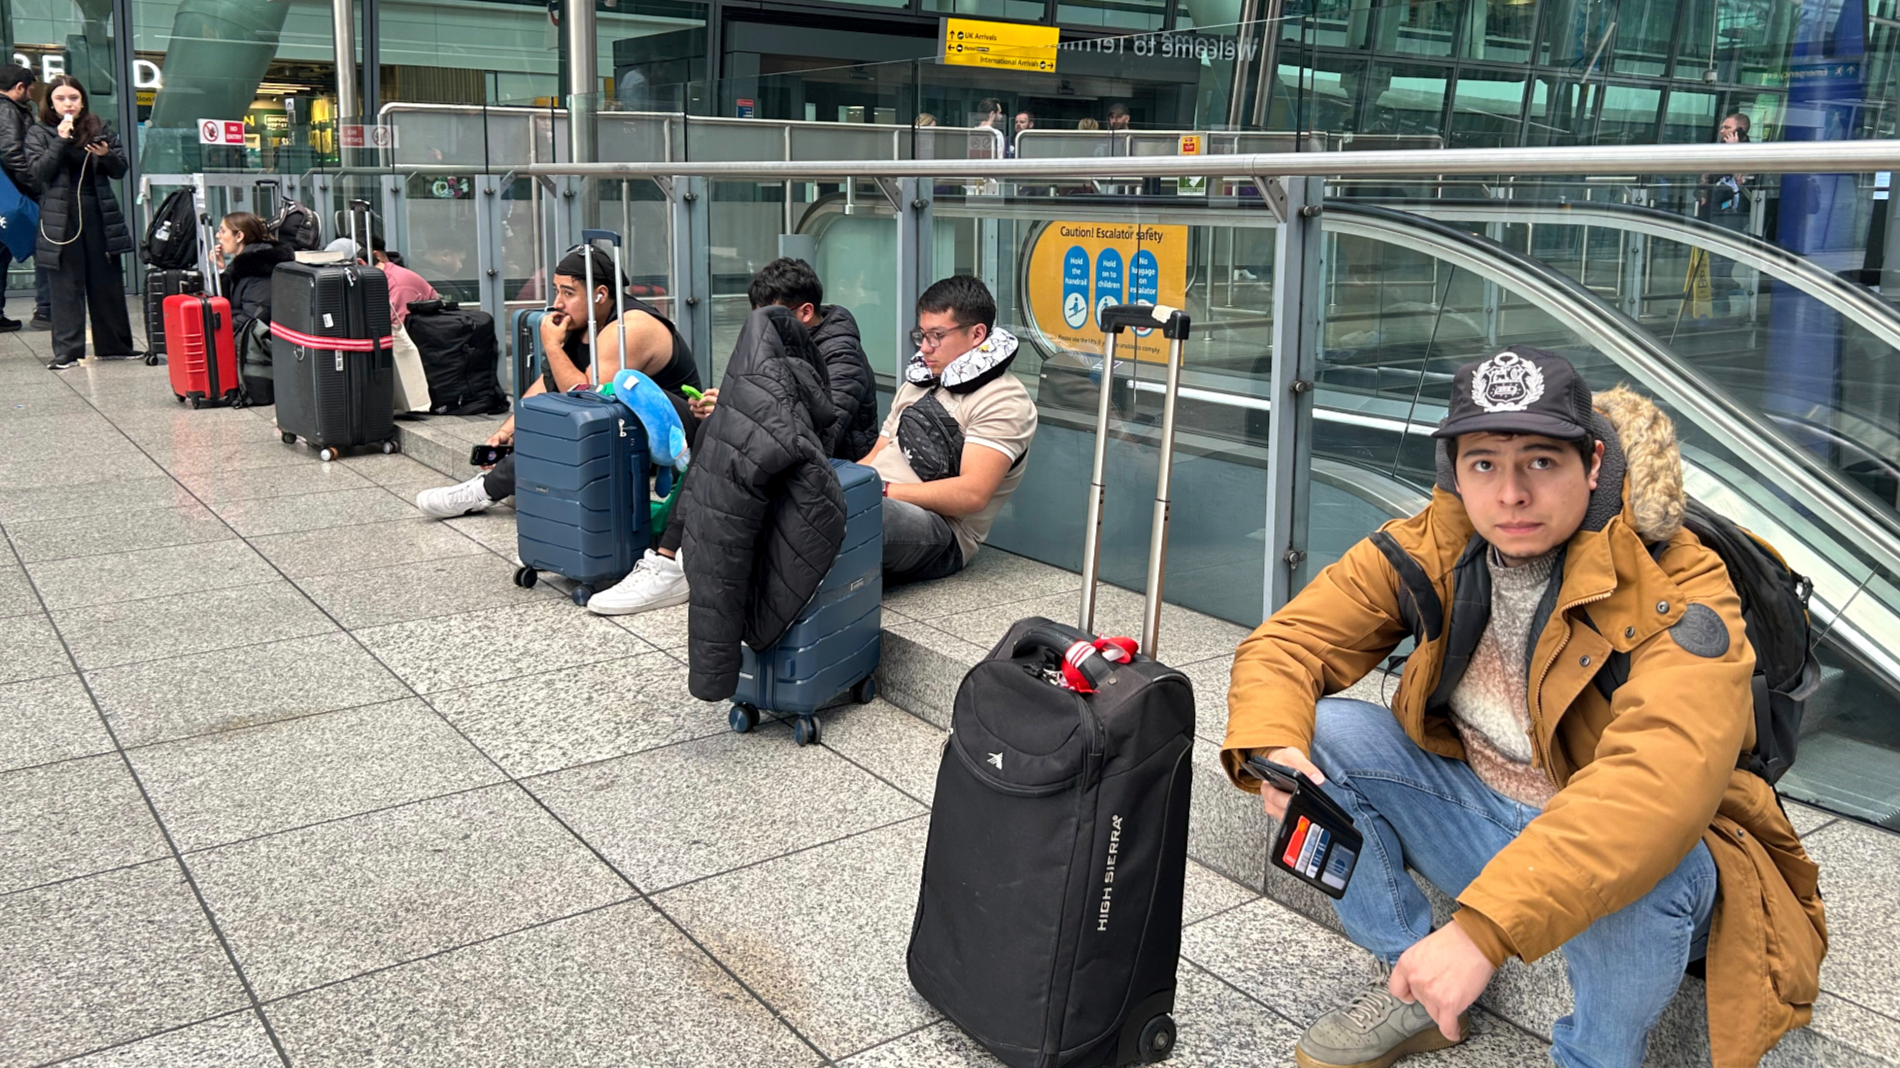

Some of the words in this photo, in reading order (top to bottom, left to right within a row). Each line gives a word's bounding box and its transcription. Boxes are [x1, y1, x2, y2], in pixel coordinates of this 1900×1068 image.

[964, 30, 974, 39] UK
[975, 32, 997, 41] Arrivals
[980, 56, 1017, 66] International
[1017, 59, 1039, 68] Arrivals
[1060, 226, 1094, 238] Caution!
[1096, 227, 1134, 240] Escalator
[1136, 228, 1163, 244] safety
[1070, 257, 1083, 265] Hold
[1102, 260, 1116, 268] Hold
[1139, 257, 1149, 265] No
[1071, 267, 1081, 275] the
[1110, 270, 1117, 278] to
[1065, 277, 1088, 286] handrail
[1098, 280, 1120, 289] children
[1130, 286, 1157, 295] esalator
[1097, 887, 1112, 931] HIGH
